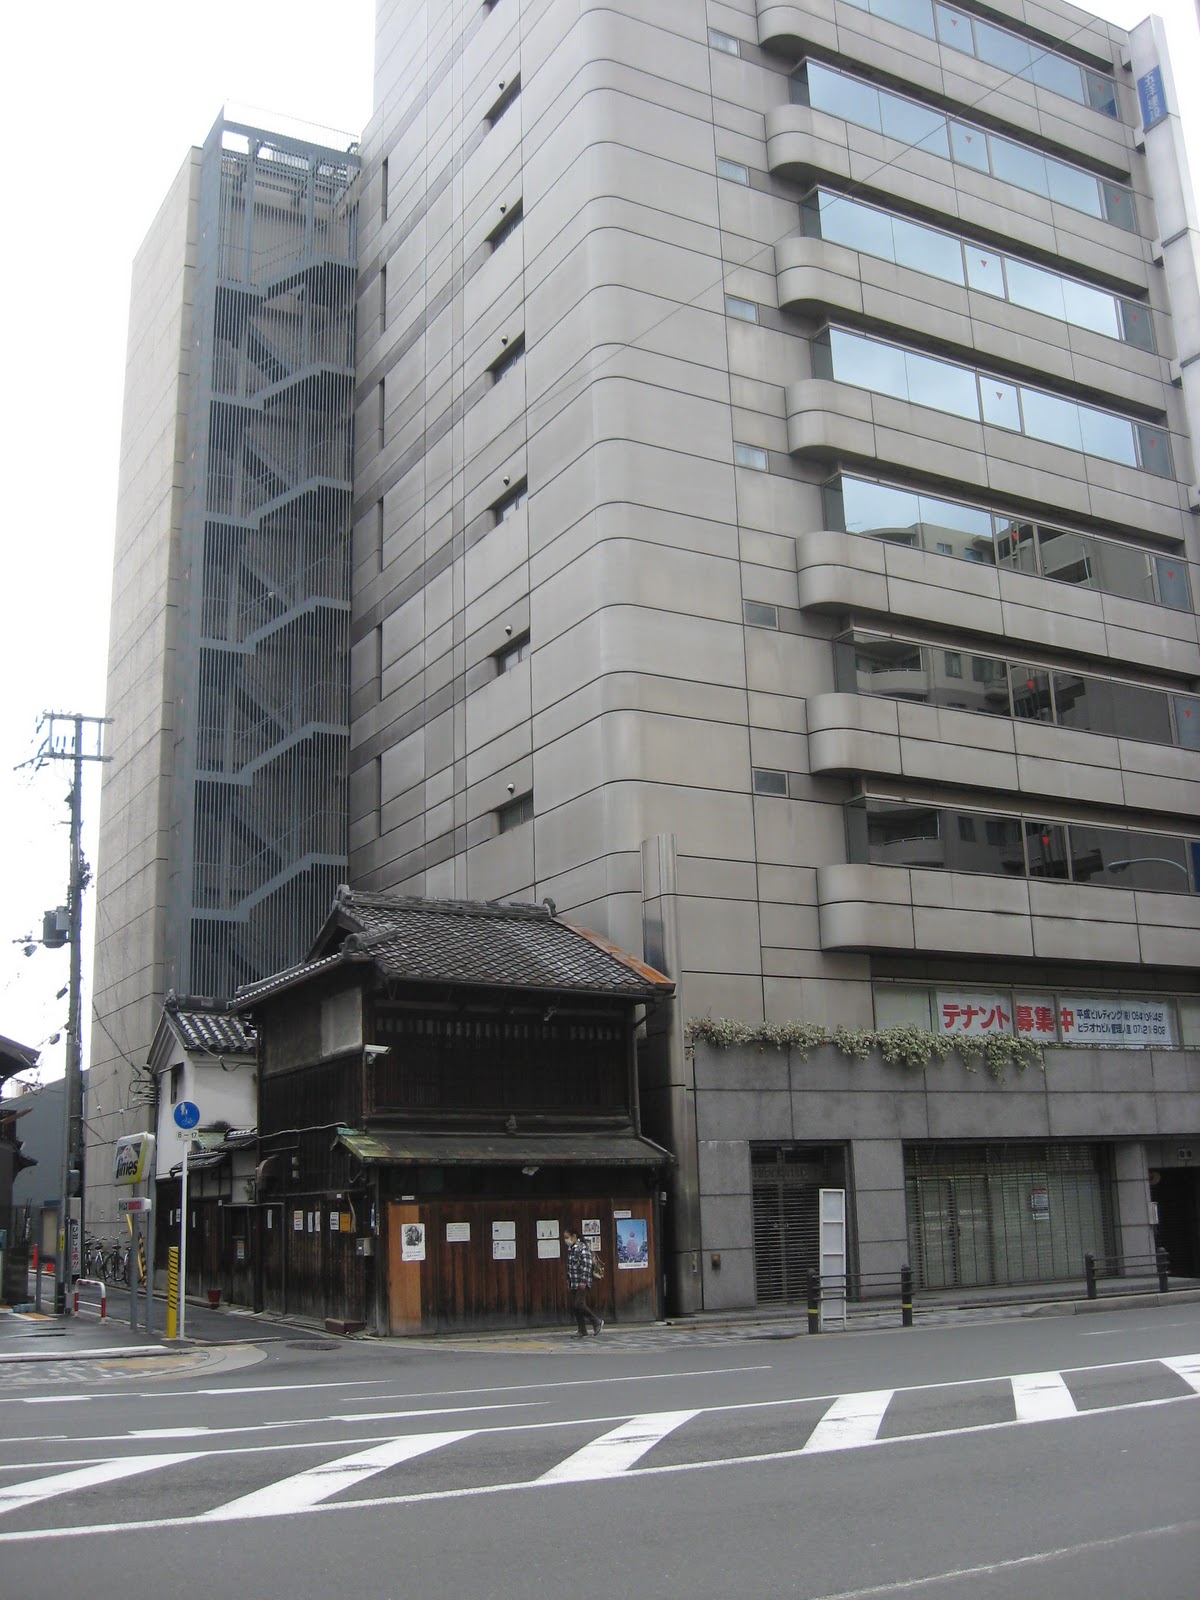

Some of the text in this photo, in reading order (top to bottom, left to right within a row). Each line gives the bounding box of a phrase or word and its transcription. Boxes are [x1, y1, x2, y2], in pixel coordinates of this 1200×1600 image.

[943, 1004, 1074, 1032] テナント募集中
